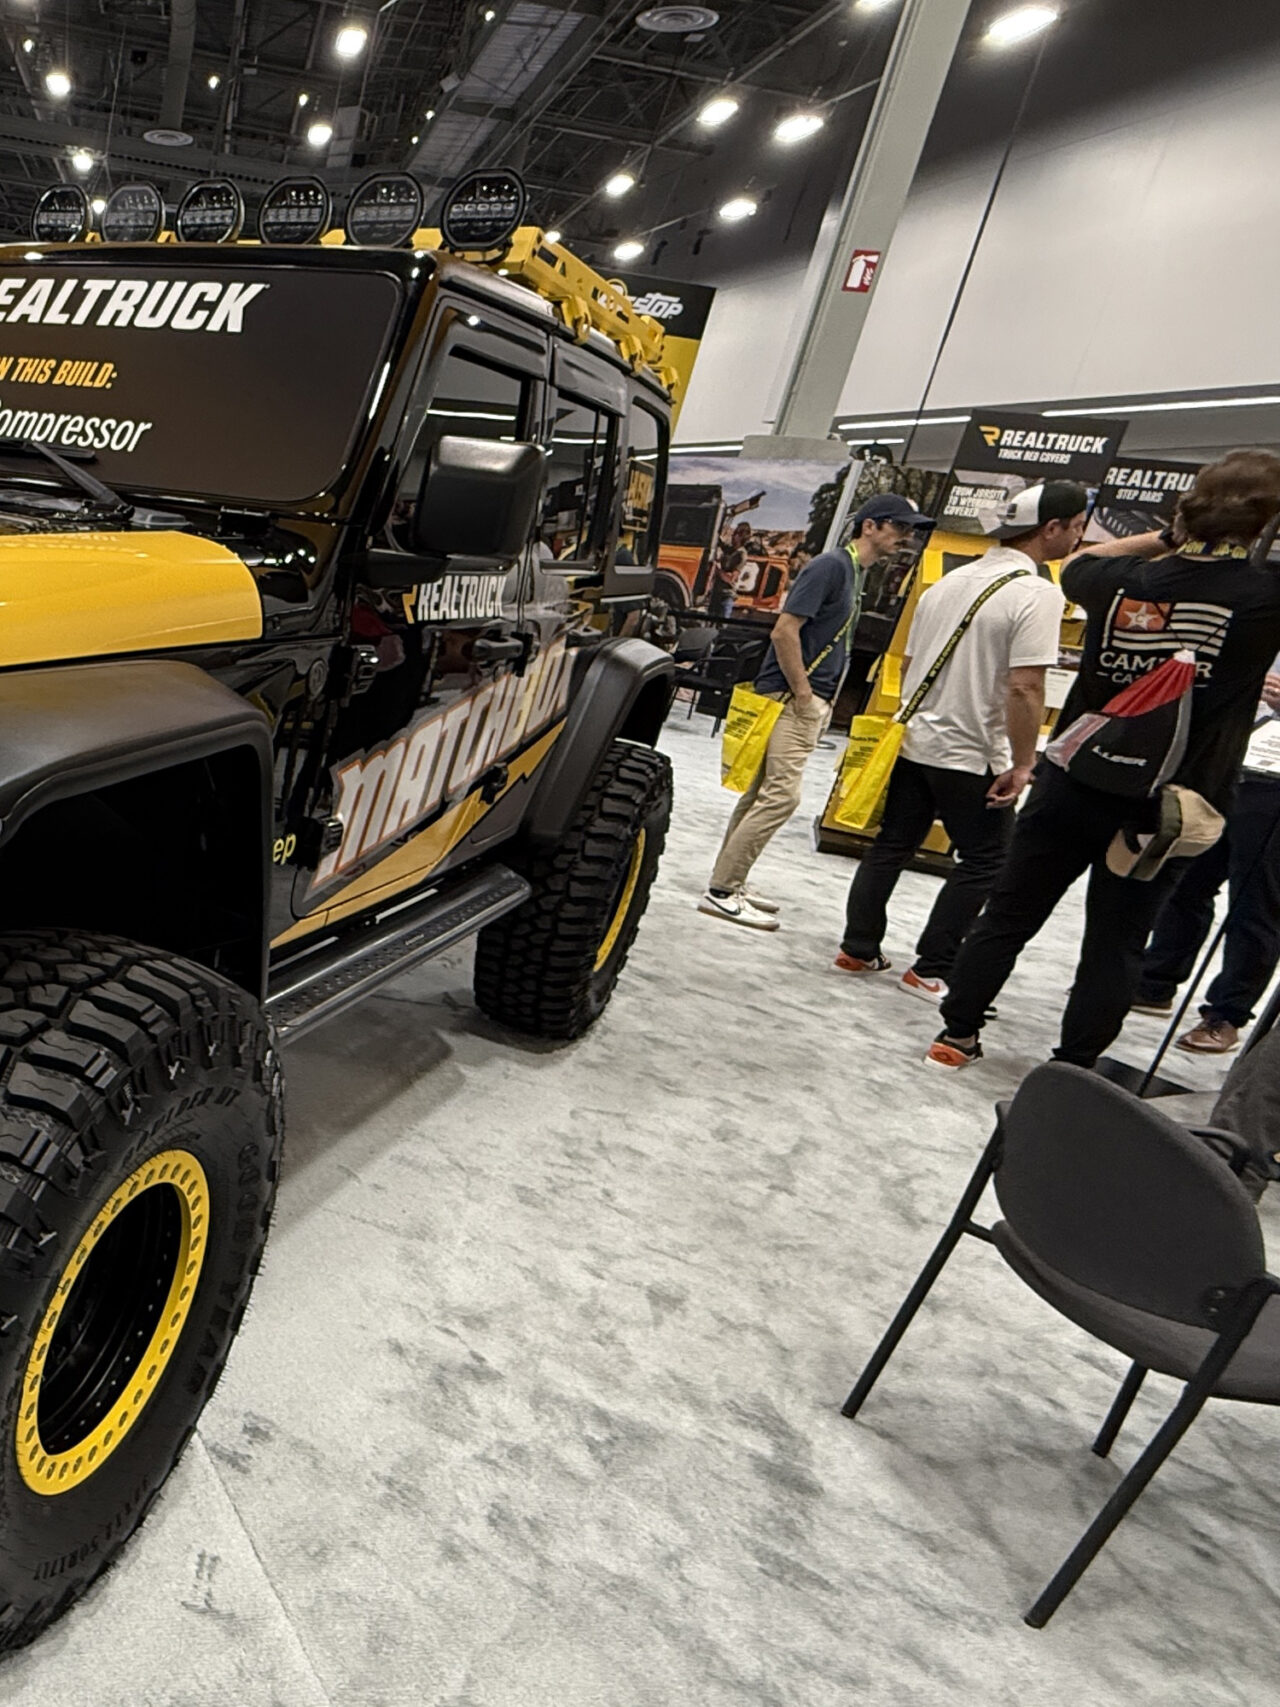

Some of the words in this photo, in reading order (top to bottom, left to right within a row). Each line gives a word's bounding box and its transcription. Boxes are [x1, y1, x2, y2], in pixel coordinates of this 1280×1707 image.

[10, 357, 56, 385] THIS
[51, 361, 117, 389] BUILD:
[1000, 429, 1109, 454] REALTRUCK
[998, 448, 1024, 460] TRUCK
[1023, 450, 1040, 462] BED
[1039, 452, 1072, 465] COVERS
[1104, 466, 1197, 492] REALTRU
[1116, 488, 1140, 500] STEP
[1138, 490, 1164, 503] BARS
[417, 574, 508, 621] REALTRUCK
